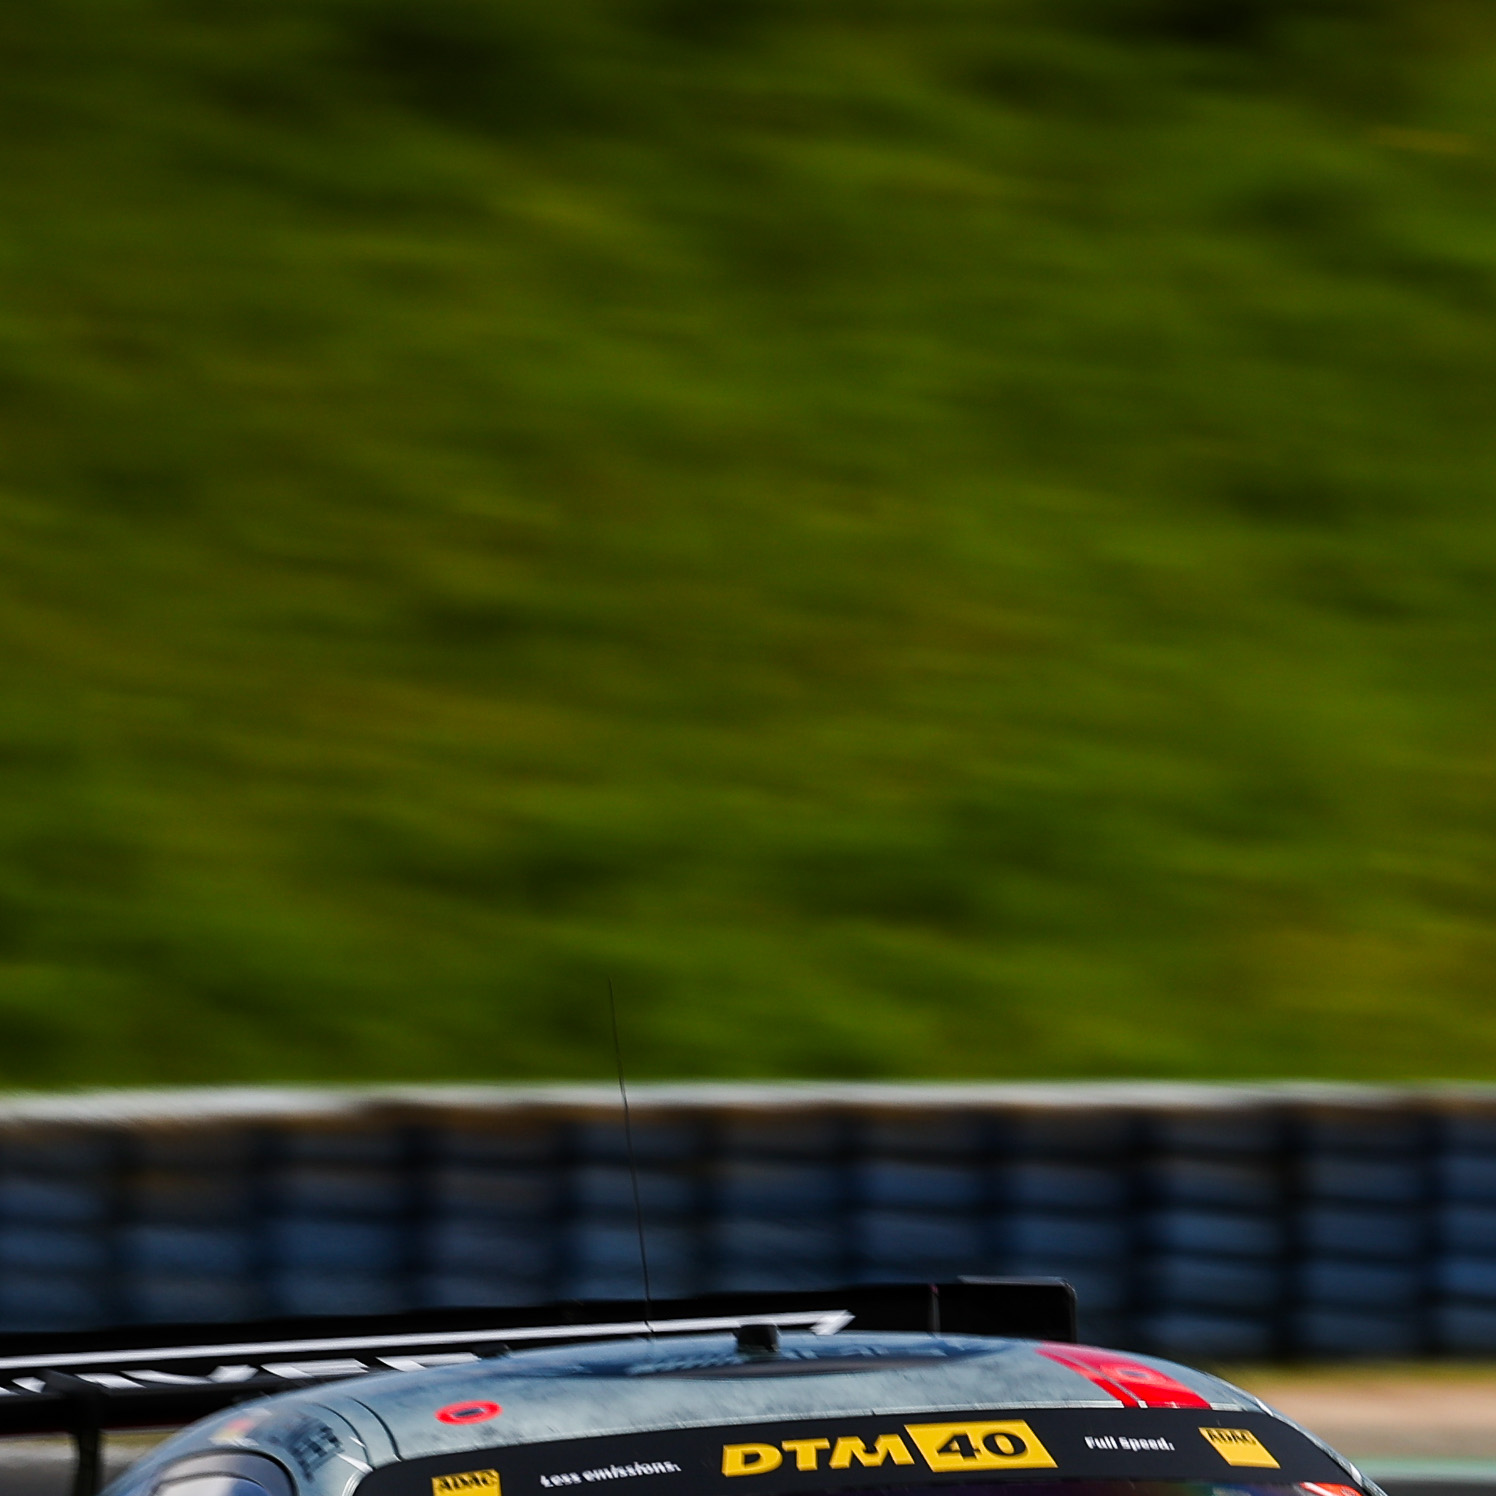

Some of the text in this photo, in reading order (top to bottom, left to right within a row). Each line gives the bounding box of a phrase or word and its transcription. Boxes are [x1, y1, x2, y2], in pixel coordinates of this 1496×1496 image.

[1084, 1436, 1118, 1450] Full
[722, 1432, 1030, 1477] DTM 40
[437, 1471, 498, 1493] ADAC
[539, 1473, 581, 1488] Less
